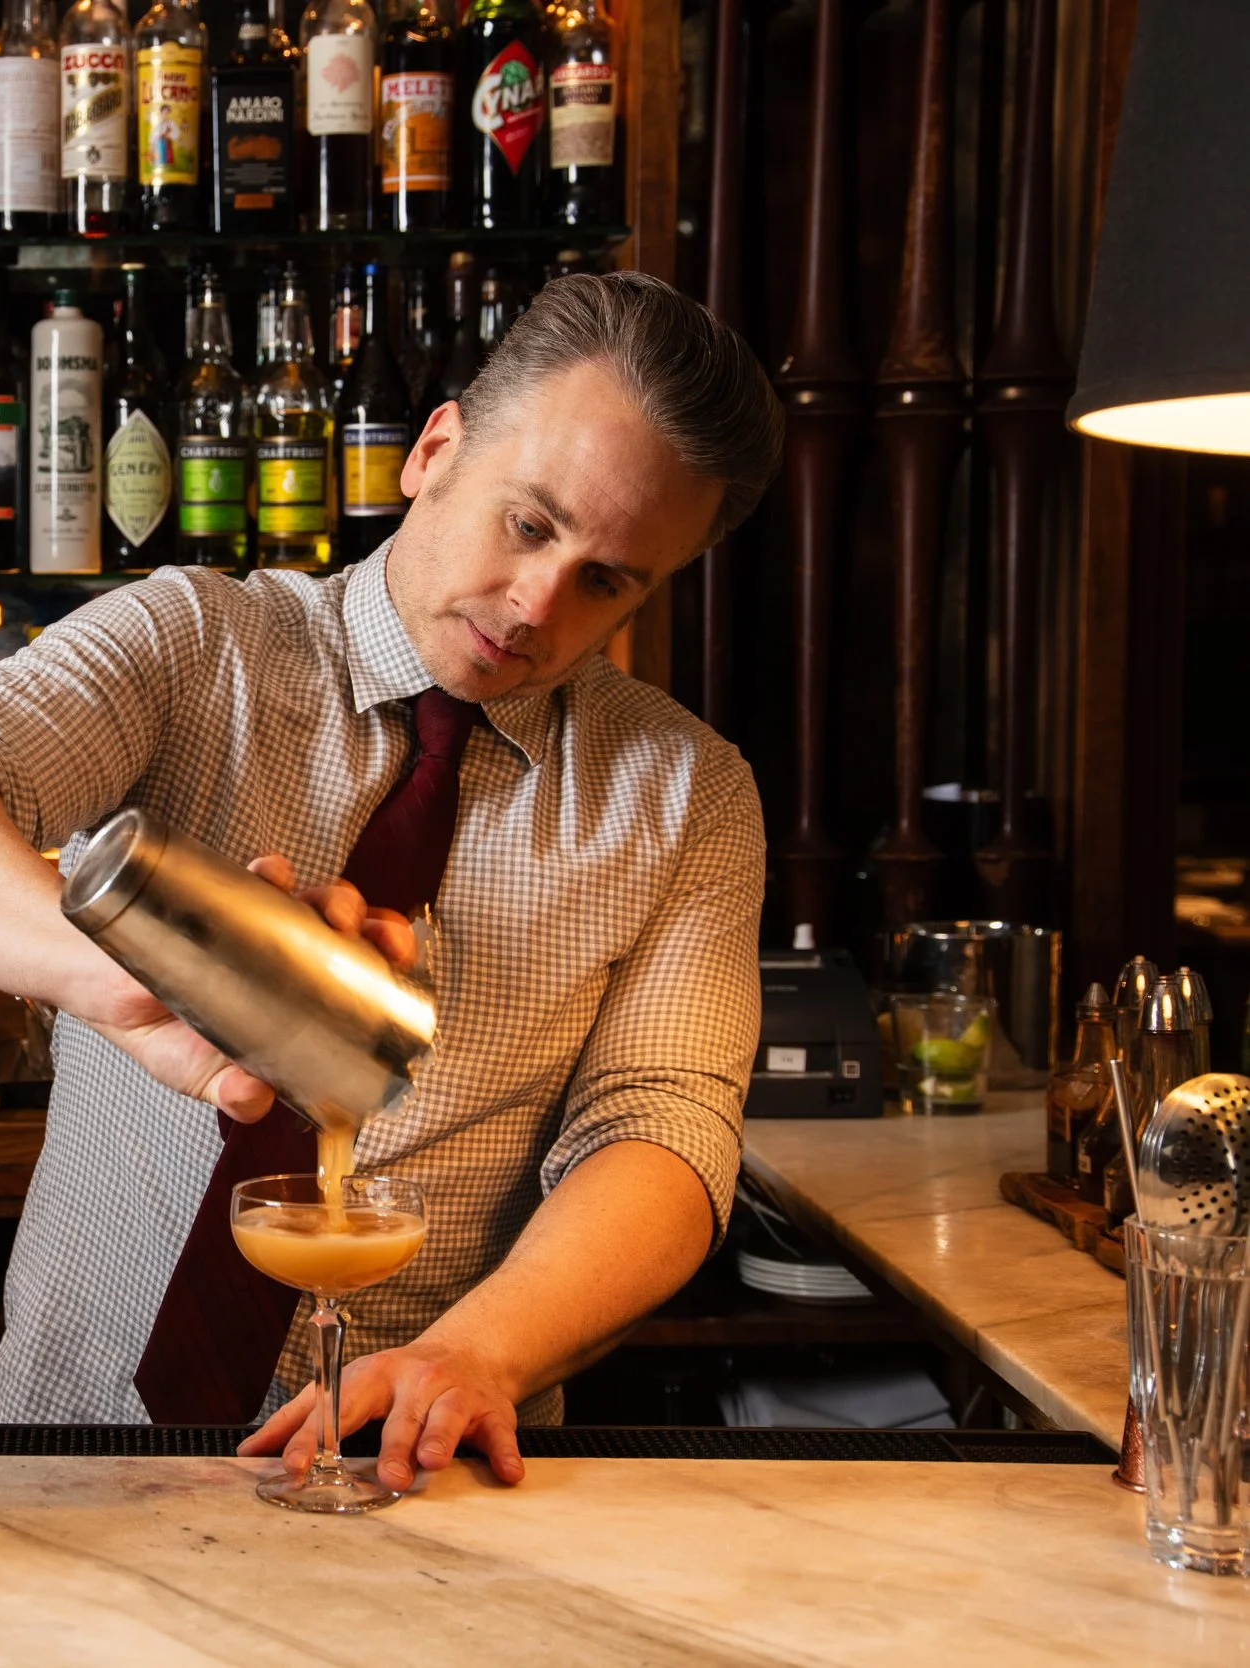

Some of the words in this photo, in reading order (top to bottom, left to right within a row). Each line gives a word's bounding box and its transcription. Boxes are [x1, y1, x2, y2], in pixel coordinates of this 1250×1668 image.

[64, 52, 124, 71] ZUCCA
[229, 96, 283, 110] AMARO
[226, 108, 284, 123] NARDINI
[36, 355, 98, 371] BOMSMA
